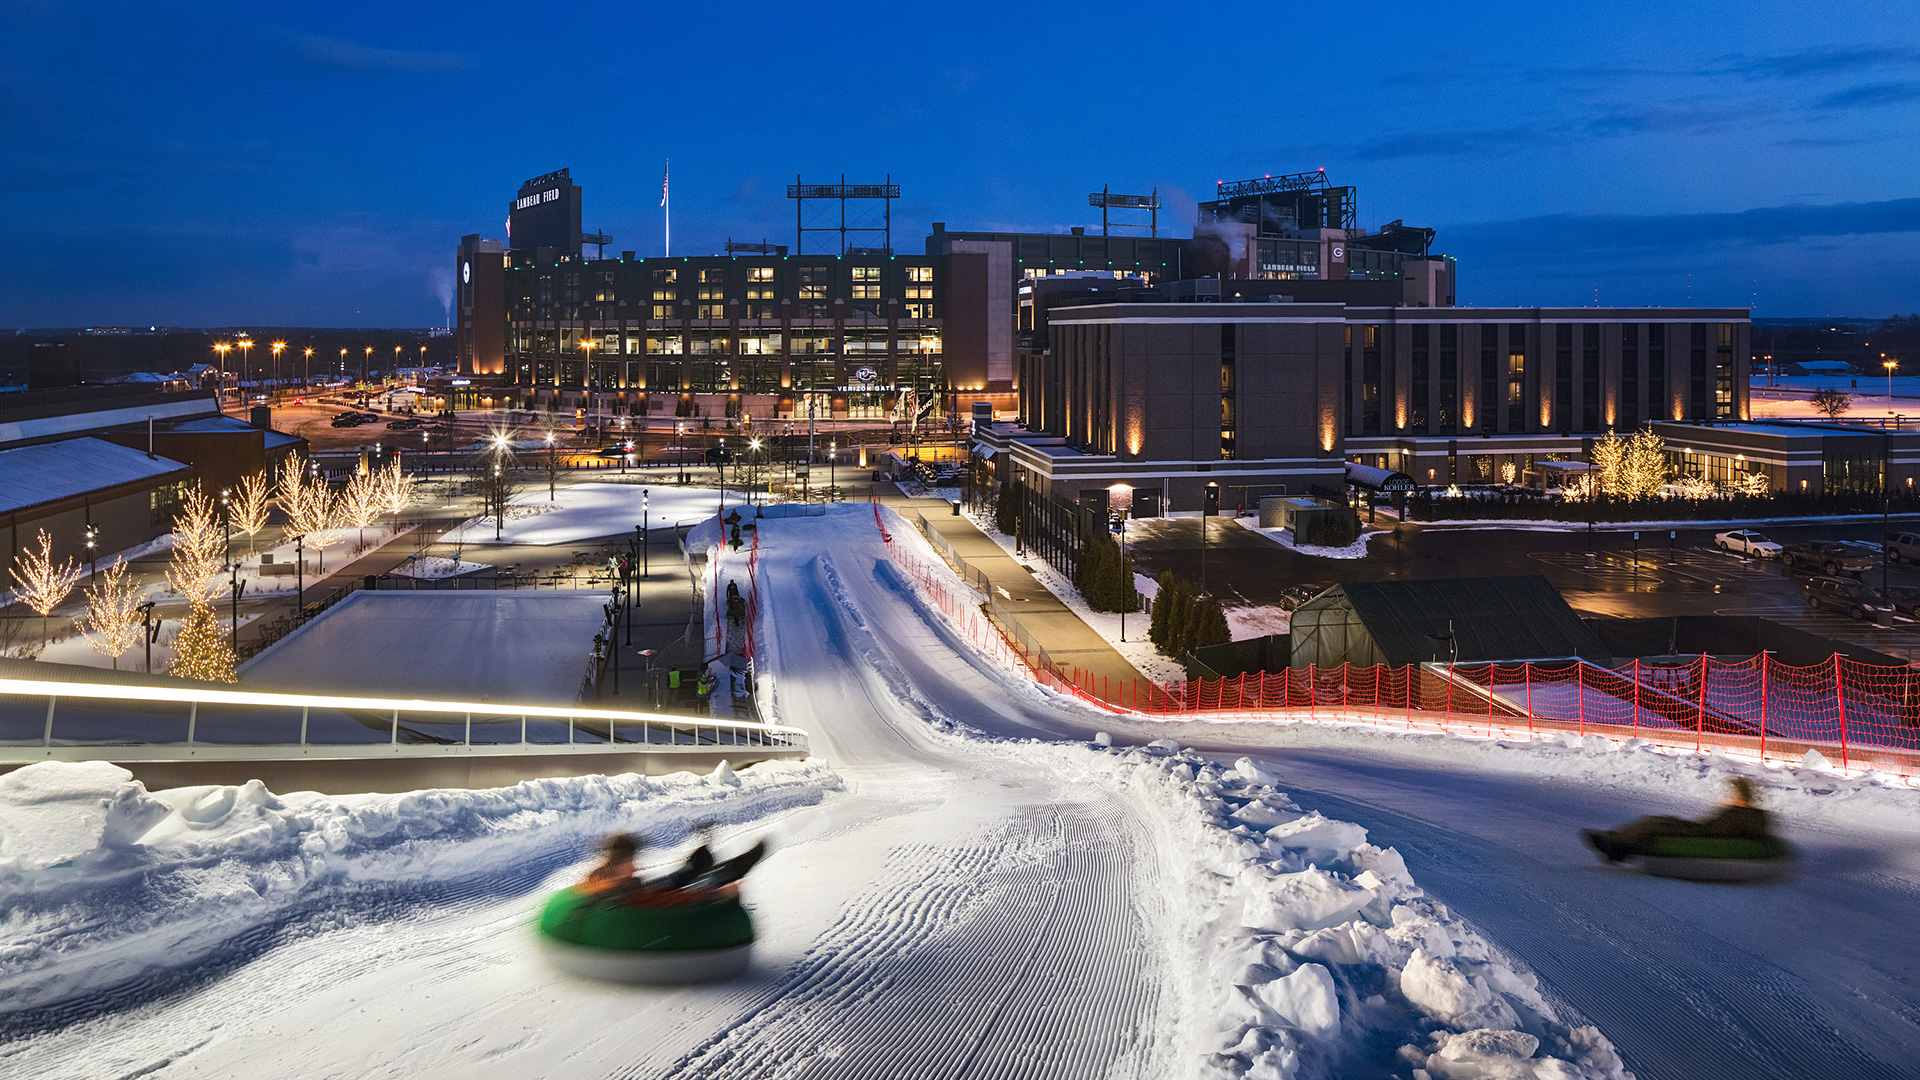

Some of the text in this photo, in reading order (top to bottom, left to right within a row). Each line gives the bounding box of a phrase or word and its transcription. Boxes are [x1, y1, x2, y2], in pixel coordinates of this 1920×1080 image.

[1226, 176, 1312, 196] LAMBEAU FIELD
[517, 188, 560, 210] LAMBEAU FIELD
[1333, 247, 1344, 258] G
